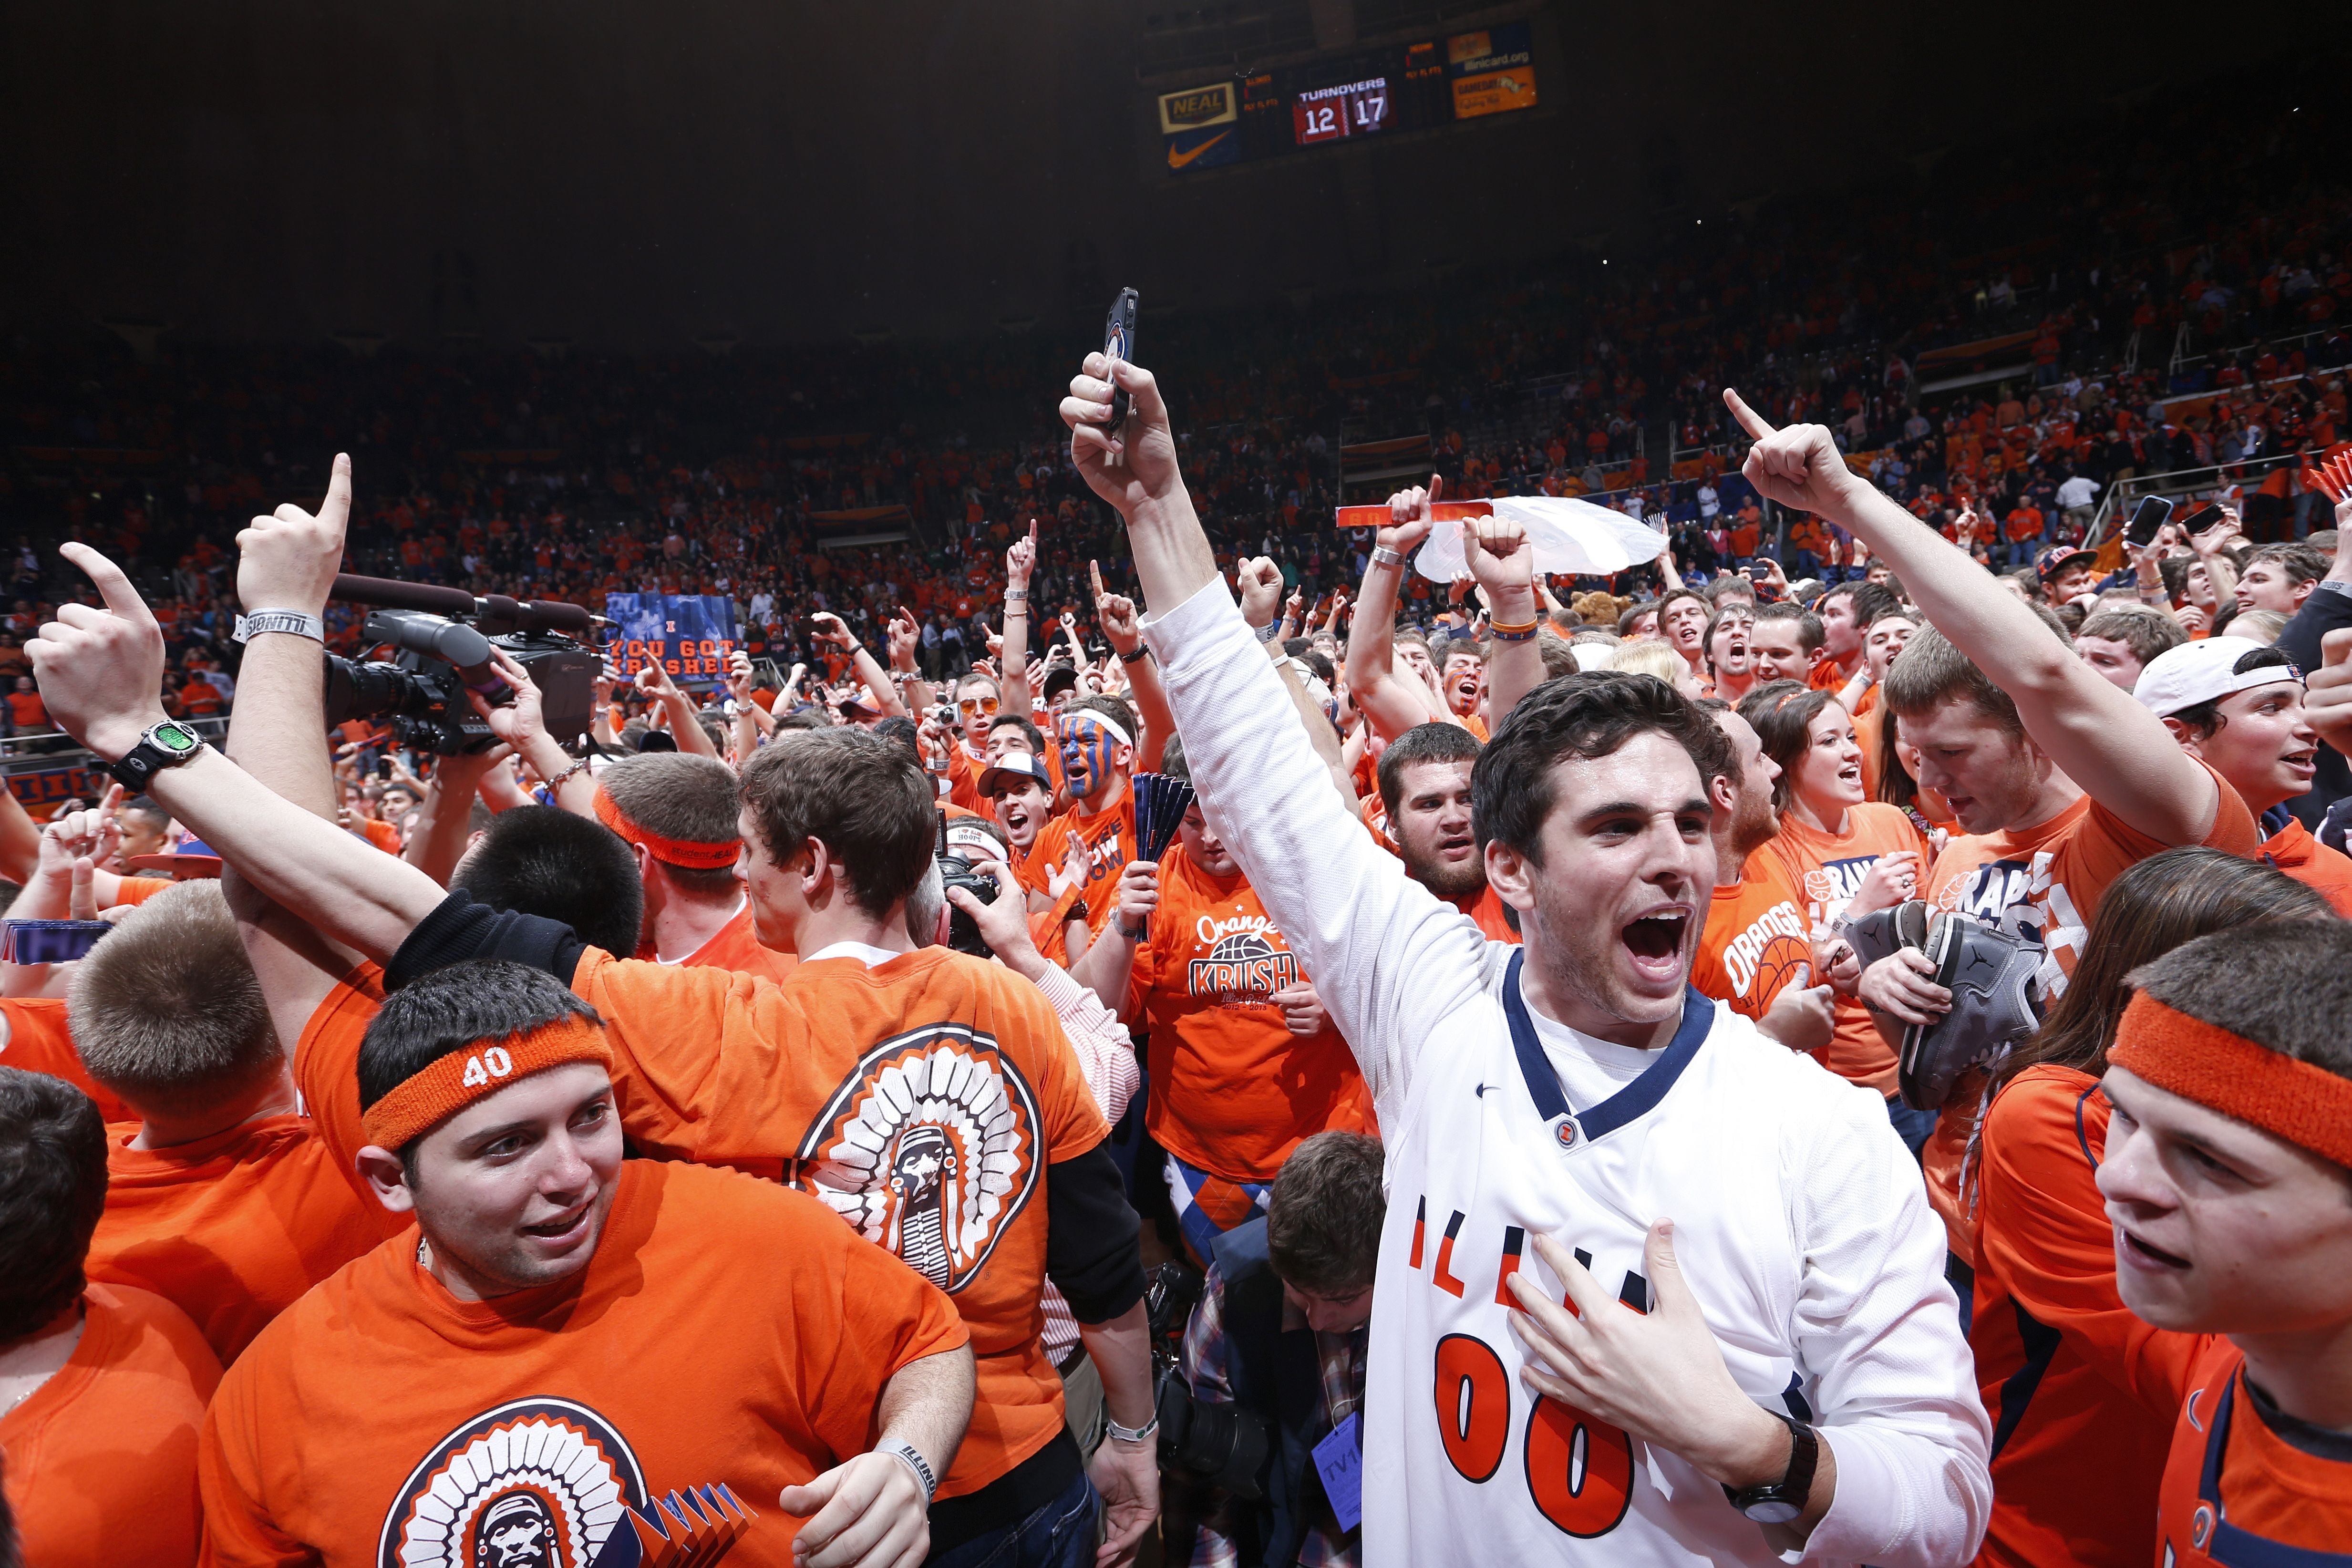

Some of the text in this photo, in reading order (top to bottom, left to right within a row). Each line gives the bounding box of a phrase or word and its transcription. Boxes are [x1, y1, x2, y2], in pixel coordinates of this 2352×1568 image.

[1173, 92, 1222, 115] NEAL
[1299, 78, 1386, 103] TURNOVERS
[1305, 96, 1383, 135] 12 17
[248, 616, 306, 636] ILLINOIS
[609, 639, 735, 657] YOU GOT
[612, 658, 733, 675] KRSHED
[671, 846, 710, 858] student
[958, 834, 981, 843] HOOPS
[1092, 835, 1118, 866] OW
[1083, 849, 1124, 887] OW
[1197, 915, 1279, 945] Orange
[1723, 900, 1810, 999] ORANGE
[1194, 955, 1293, 995] KRUSH
[1221, 992, 1271, 1005] Illini Pride
[462, 1046, 513, 1088] 40
[1434, 1332, 1635, 1539] 00
